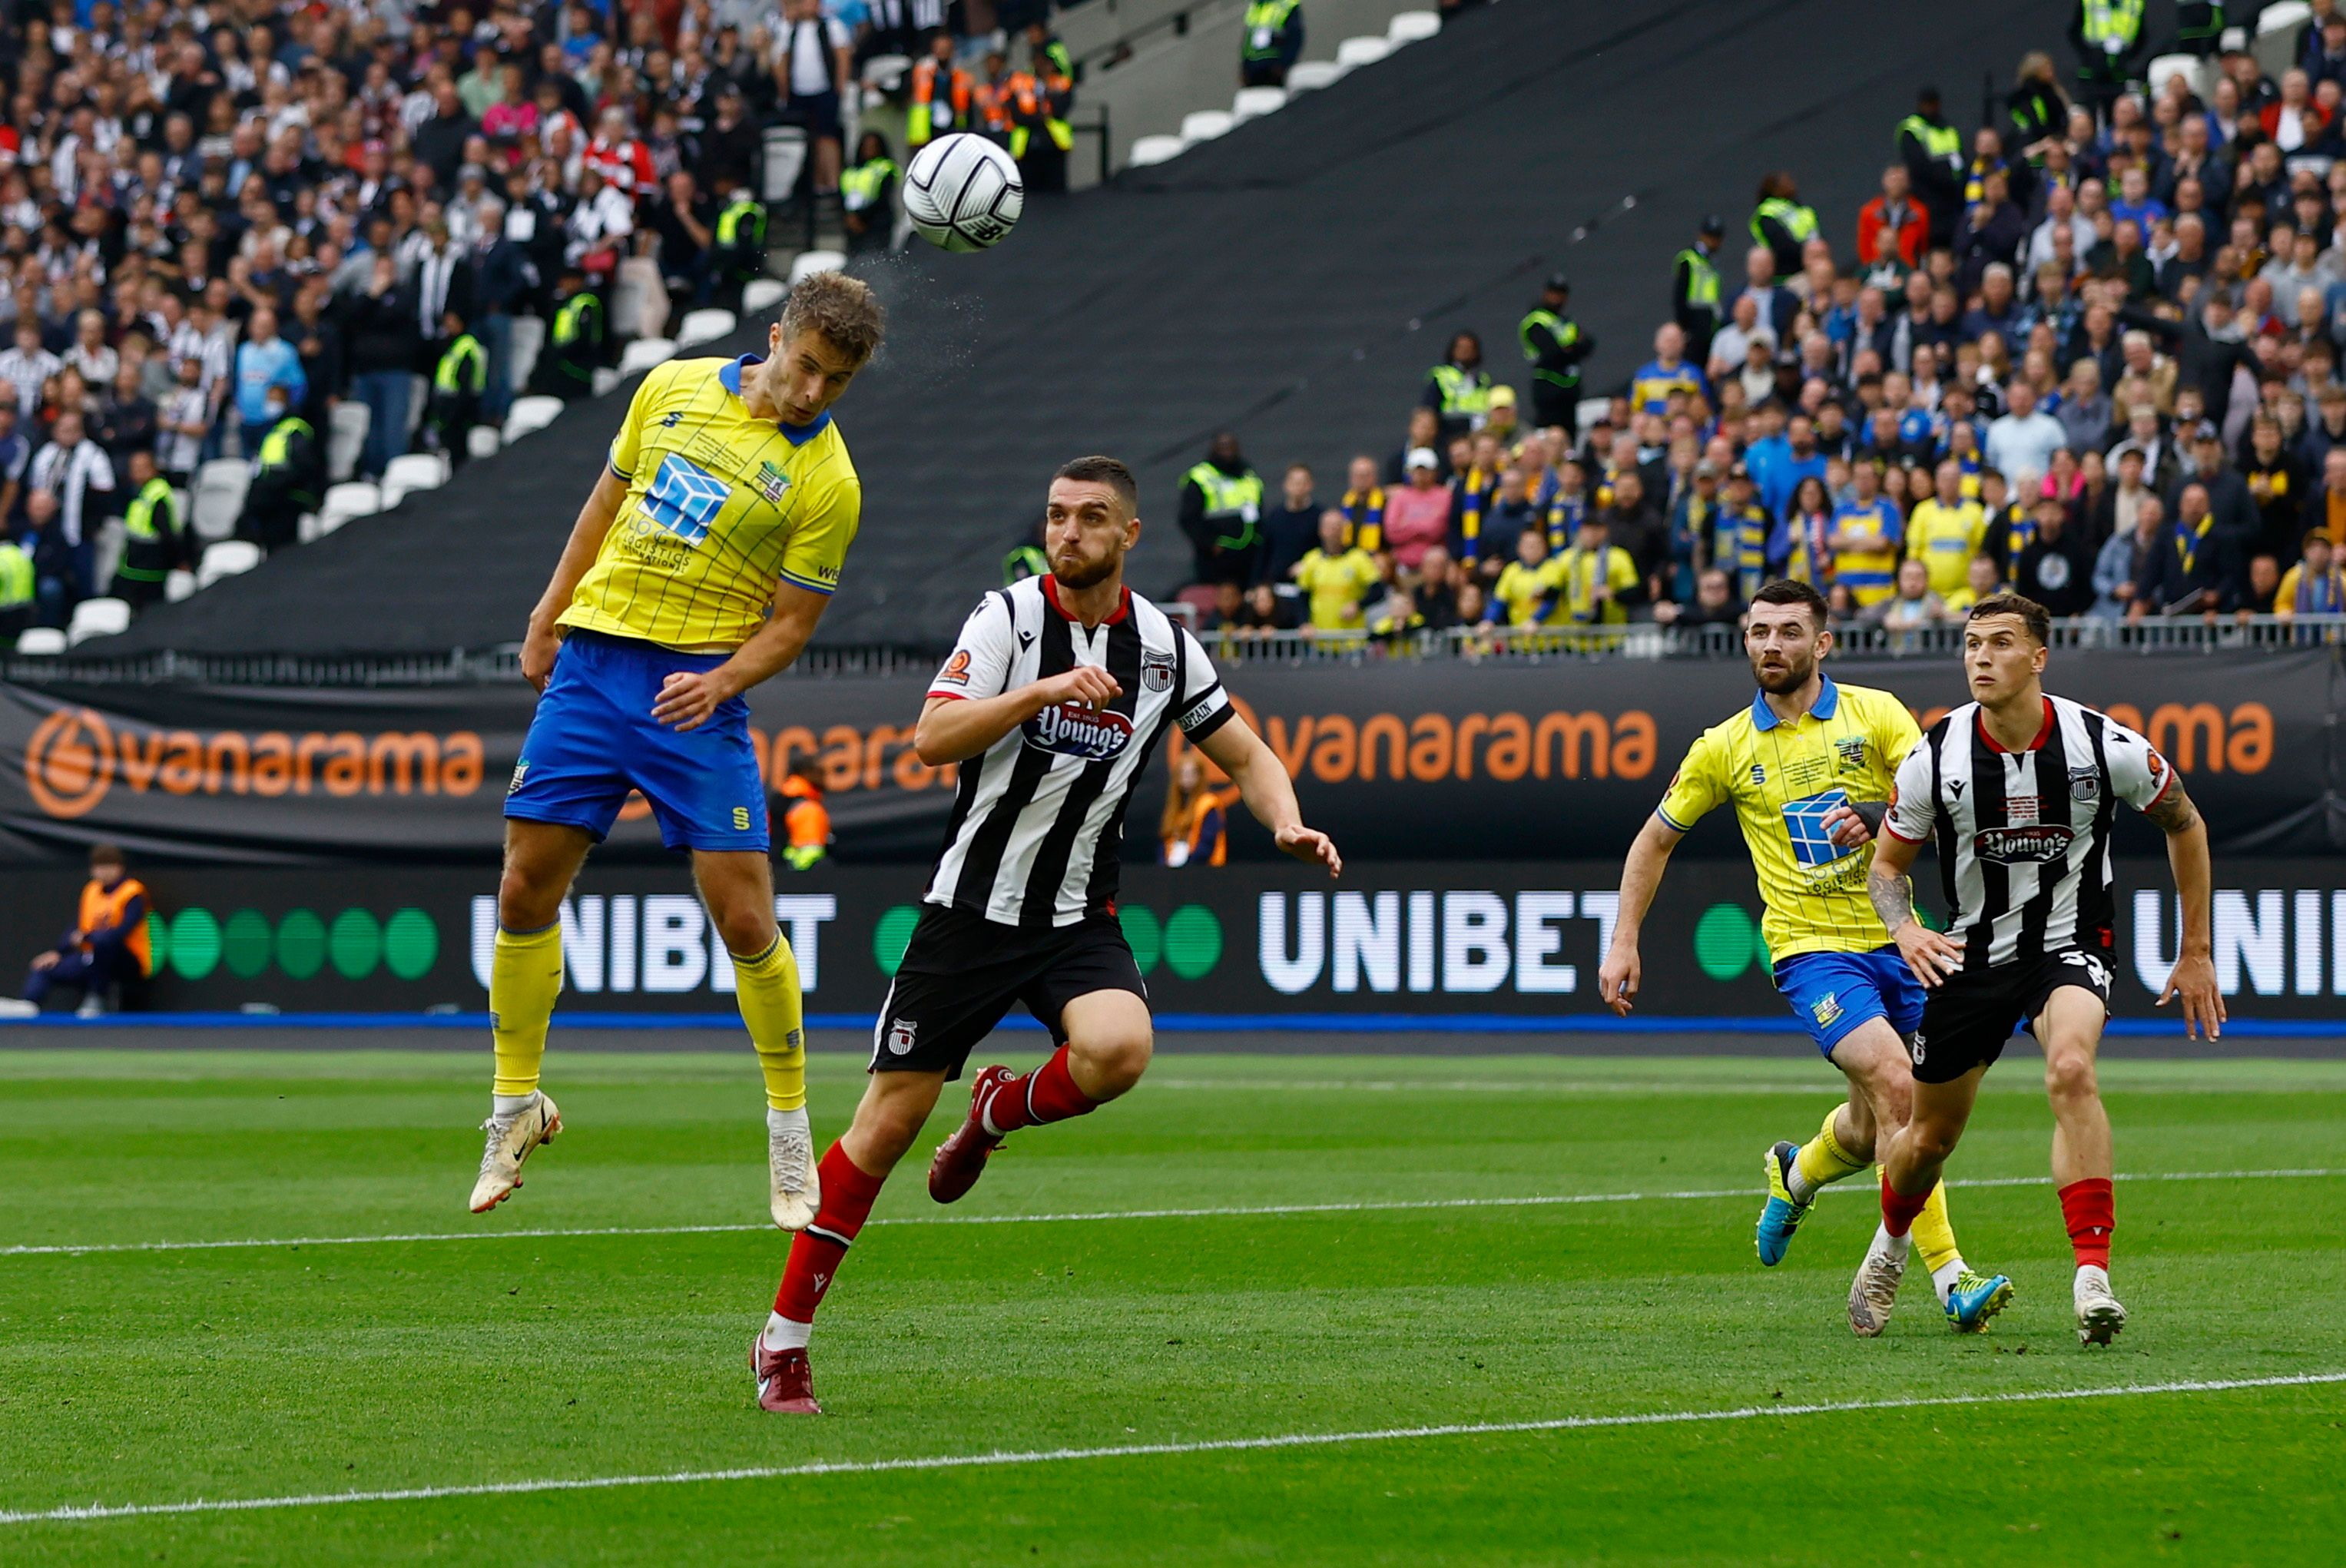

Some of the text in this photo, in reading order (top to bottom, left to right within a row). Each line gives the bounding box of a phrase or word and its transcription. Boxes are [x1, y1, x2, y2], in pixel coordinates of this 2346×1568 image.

[623, 532, 691, 566] LOGISTICS
[117, 730, 484, 797] vanarama
[1032, 705, 1127, 757] Young's
[1266, 710, 1658, 784] vanarama
[1984, 832, 2069, 860] Young's
[471, 893, 837, 993] NIBT
[2133, 890, 2346, 996] UNI
